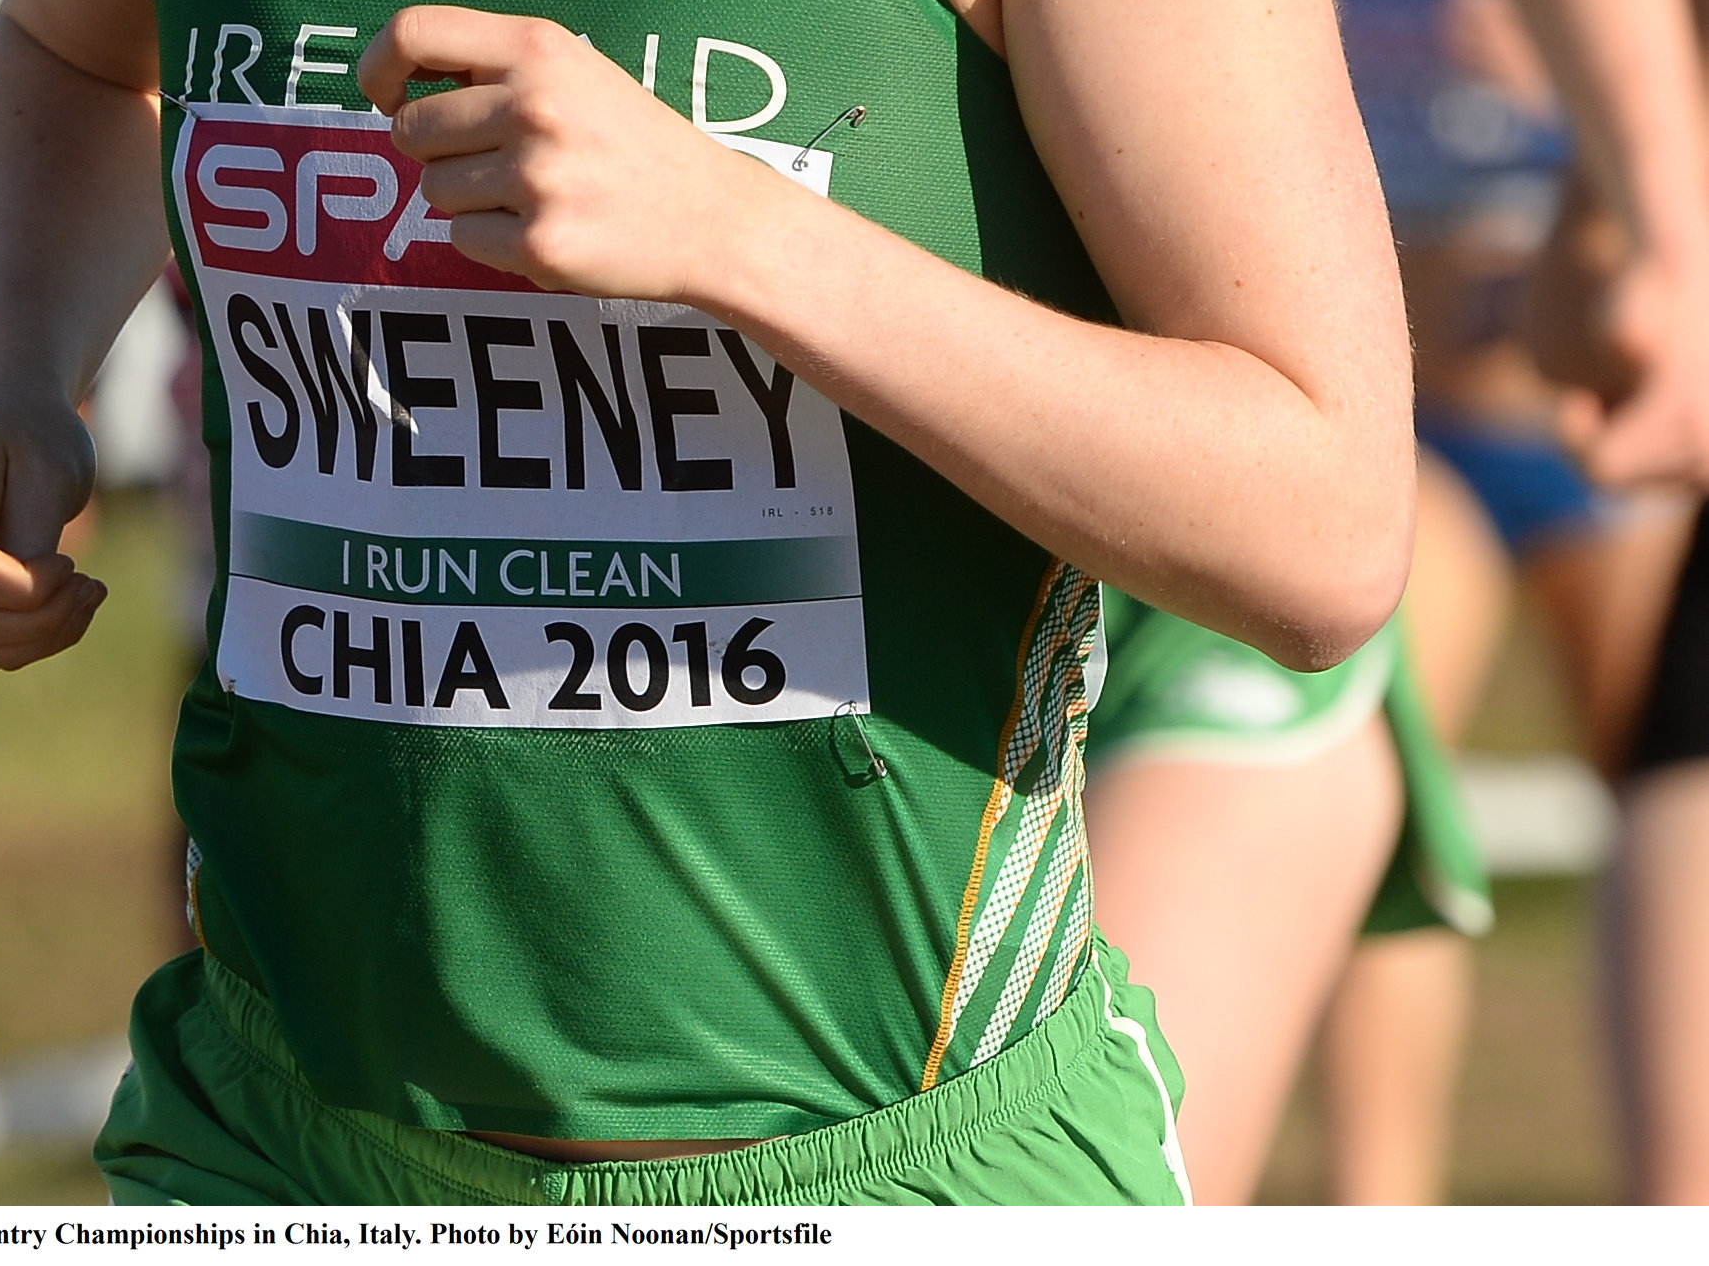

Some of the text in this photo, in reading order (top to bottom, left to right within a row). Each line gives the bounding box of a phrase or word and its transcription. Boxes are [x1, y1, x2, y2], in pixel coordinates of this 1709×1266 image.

[226, 292, 797, 492] SWEENEY
[761, 508, 784, 518] IRL
[809, 506, 834, 517] 518
[340, 539, 683, 599] I RUN CLEAN
[279, 604, 788, 713] CHIA 2016
